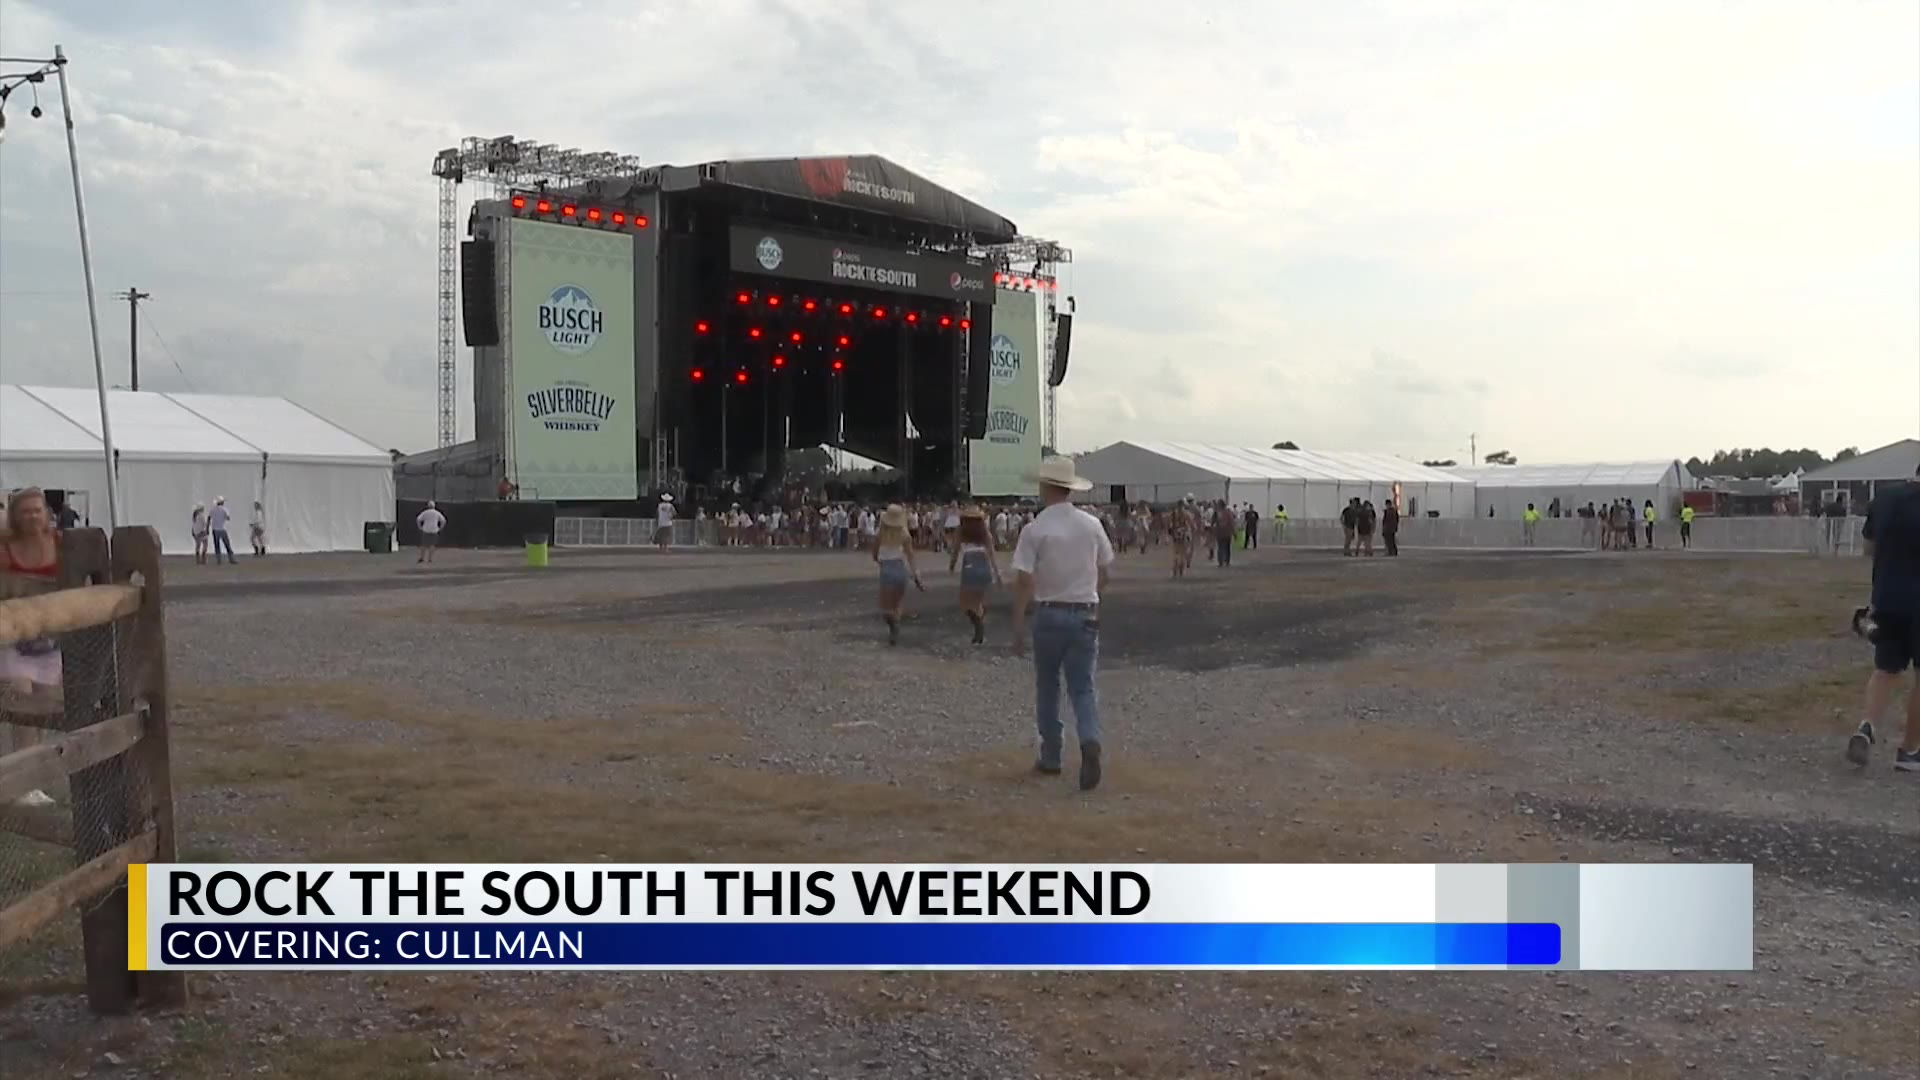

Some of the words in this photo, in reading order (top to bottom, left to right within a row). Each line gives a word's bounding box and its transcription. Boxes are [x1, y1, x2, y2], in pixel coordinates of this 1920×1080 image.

[539, 305, 603, 333] BUSCH
[553, 331, 590, 345] LIGHT
[991, 349, 1021, 369] USCH
[527, 387, 616, 420] SILVERBELLY
[544, 421, 601, 432] WHISKEY
